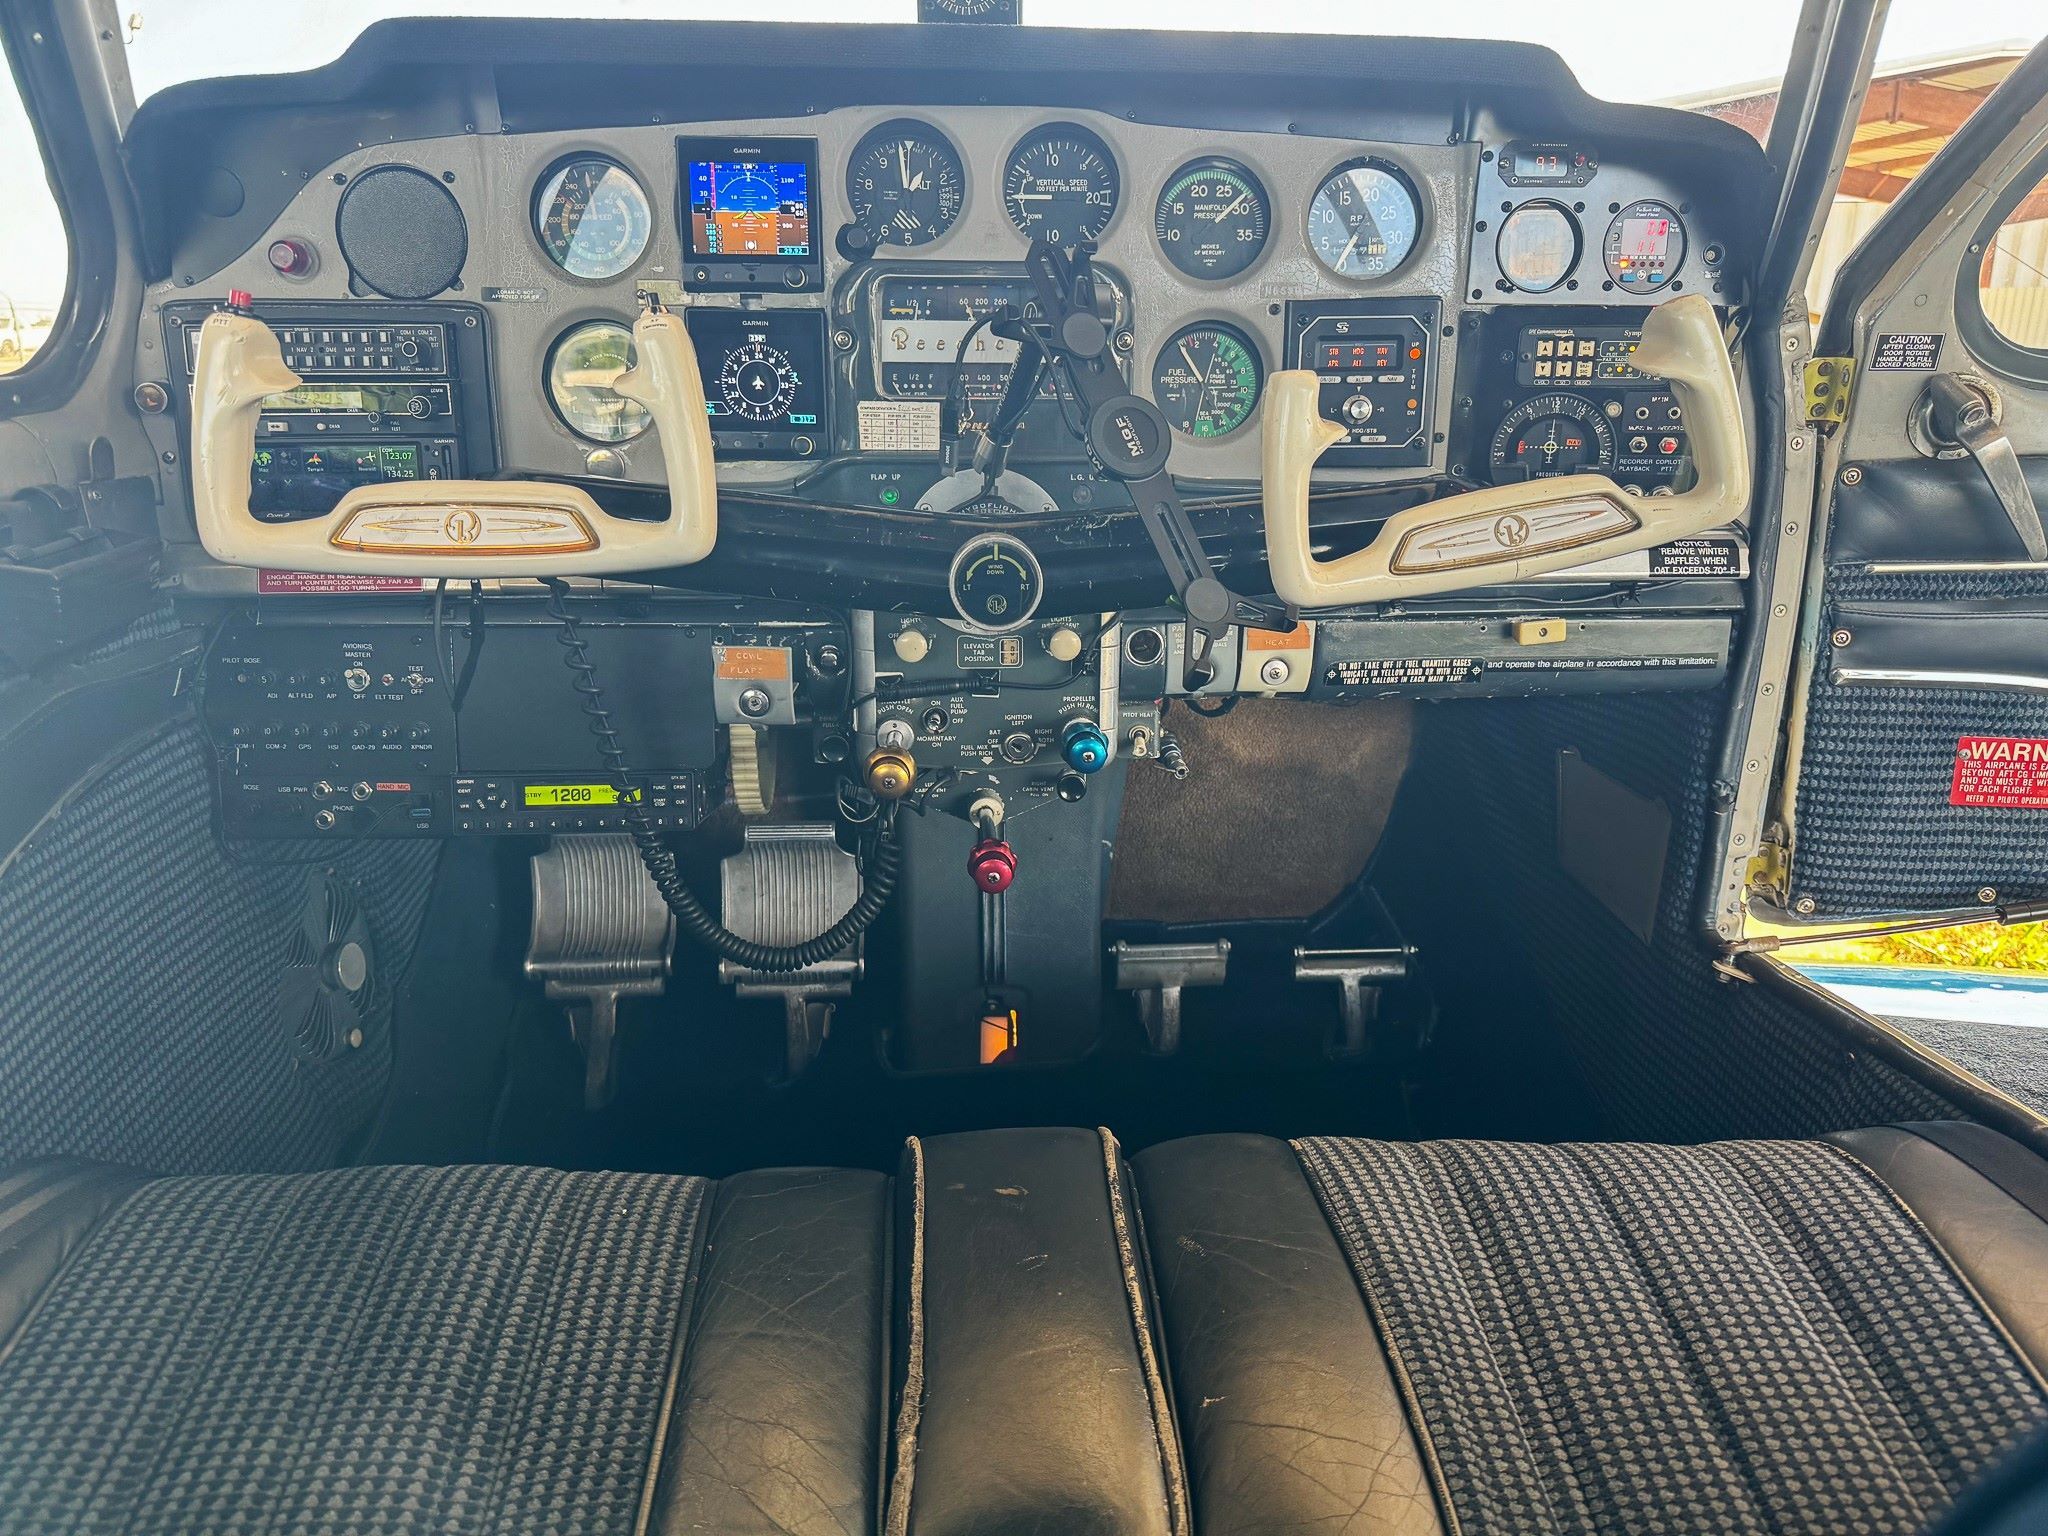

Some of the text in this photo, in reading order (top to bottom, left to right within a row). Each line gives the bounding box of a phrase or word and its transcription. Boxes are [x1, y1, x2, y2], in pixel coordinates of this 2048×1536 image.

[1191, 185, 1208, 197] 20
[1216, 185, 1232, 197] 25
[1363, 188, 1380, 202] 20
[1085, 192, 1100, 204] 20
[1173, 202, 1184, 215] 15
[1380, 206, 1397, 220] 25
[1046, 229, 1059, 242] 10
[1167, 229, 1180, 241] 10
[1236, 229, 1253, 241] 35
[1367, 257, 1384, 271] 35
[1889, 335, 1932, 344] CAUTION
[386, 452, 412, 460] 123.07
[387, 470, 414, 478] 134.25
[870, 473, 901, 481] FLAP UP
[1664, 557, 1727, 565] BAFFLES WHEN
[1349, 662, 1362, 670] NOT
[1364, 662, 1380, 670] TAKE
[1382, 661, 1394, 670] OFF
[1396, 661, 1401, 669] IF
[1405, 660, 1419, 668] FUEL
[1422, 659, 1450, 668] QUANTITY
[1487, 656, 1715, 670] and operate the airplane in accordance with this limitation.
[1340, 669, 1368, 678] INDICATE
[1370, 669, 1378, 677] IN
[1381, 669, 1404, 677] YELLOW
[1406, 668, 1423, 676] BAND
[1425, 668, 1434, 676] OR
[1452, 667, 1468, 675] LESS
[1343, 677, 1359, 685] THAN
[1362, 677, 1369, 685] 13
[1371, 676, 1399, 684] GALLONS
[1409, 675, 1425, 683] EACH
[1427, 675, 1444, 683] MAIN
[1446, 674, 1463, 682] TANK
[877, 704, 914, 715] PUSH OPEN
[1971, 741, 2048, 762] WARN
[1963, 761, 1982, 769] THIS
[1984, 761, 2027, 770] AIRPLANE
[1961, 769, 2028, 778] BEYOND AFT CG
[1981, 777, 1992, 785] CG
[1995, 778, 2019, 786] MUST
[550, 788, 591, 802] 1200
[1958, 784, 2033, 795] FOR EACH FLIGHT.
[1965, 794, 1984, 803] REFER
[1987, 795, 1995, 803] TO
[1997, 796, 2018, 804] PILOTS
